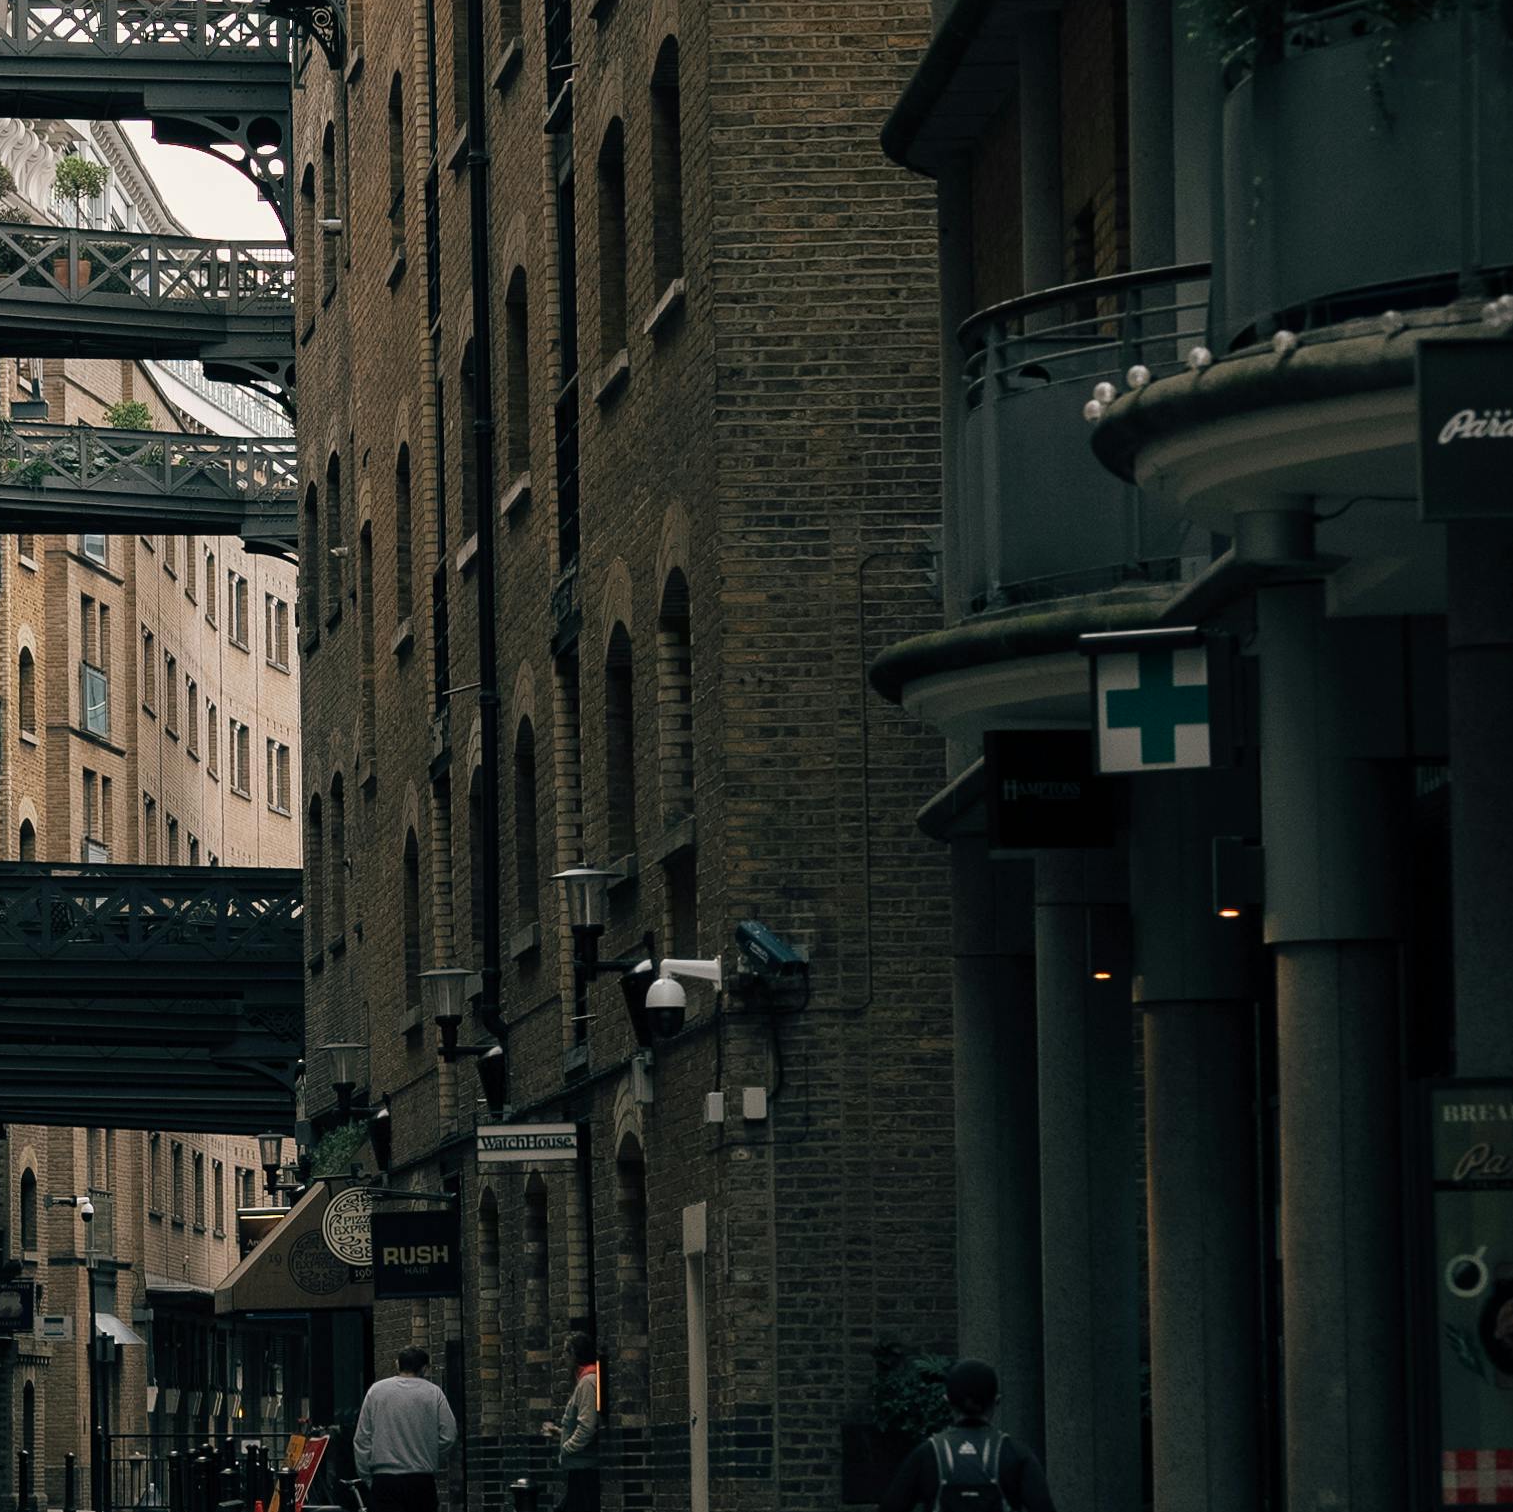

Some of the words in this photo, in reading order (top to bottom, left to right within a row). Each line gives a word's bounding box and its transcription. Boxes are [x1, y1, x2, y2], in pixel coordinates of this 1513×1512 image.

[344, 1214, 371, 1225] PIZZ
[383, 1245, 449, 1266] RUSH
[404, 1266, 430, 1277] HAIR
